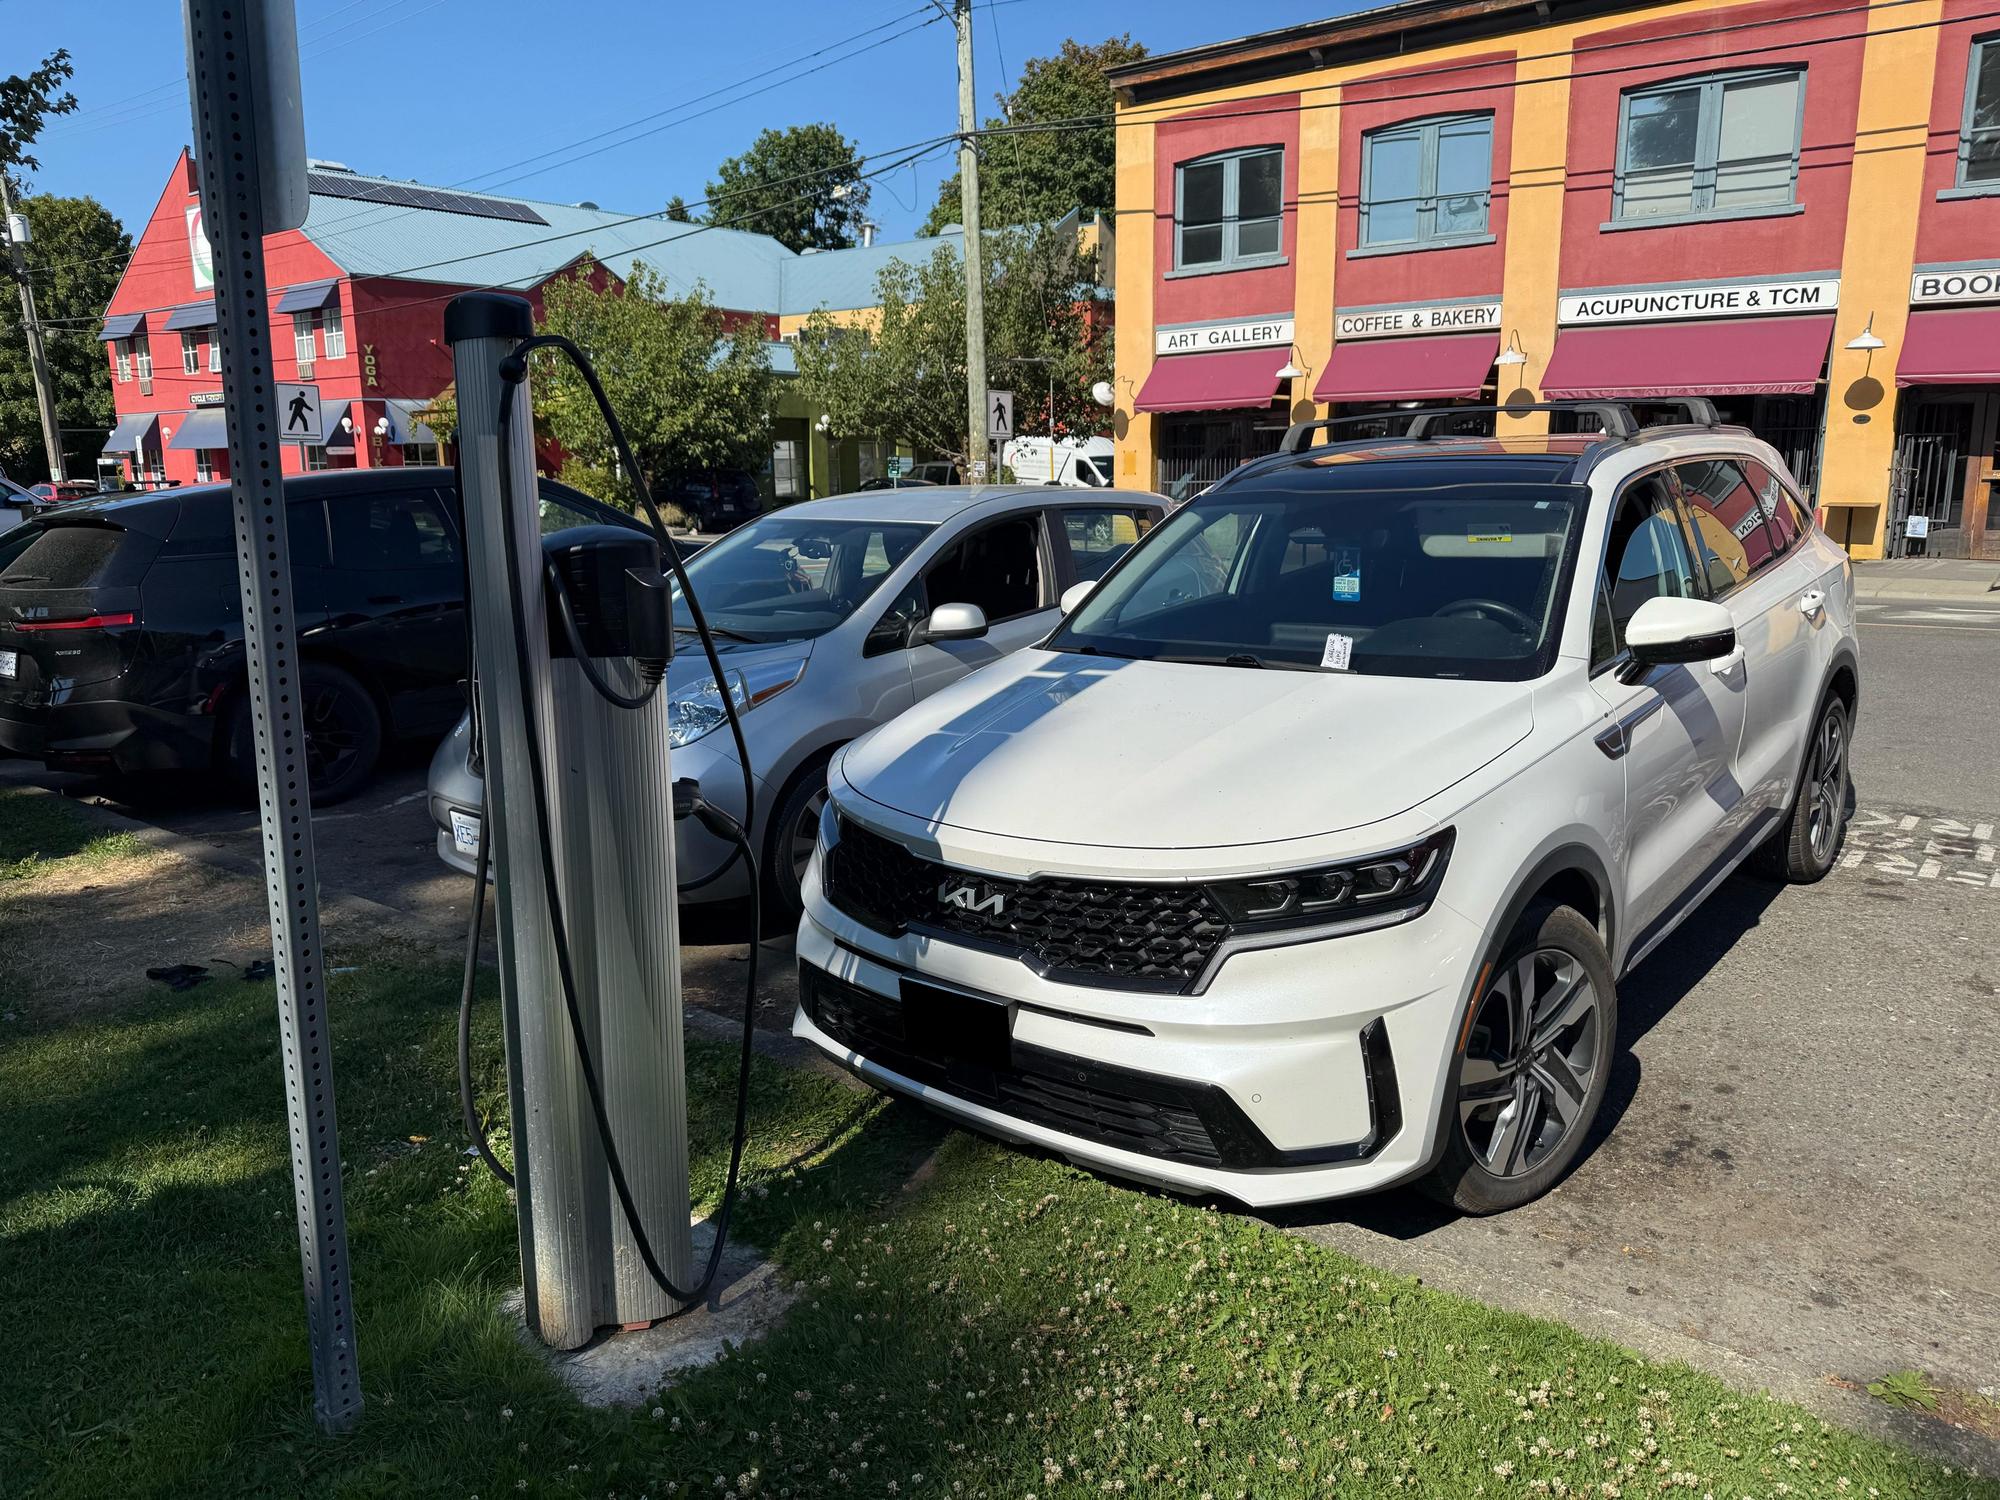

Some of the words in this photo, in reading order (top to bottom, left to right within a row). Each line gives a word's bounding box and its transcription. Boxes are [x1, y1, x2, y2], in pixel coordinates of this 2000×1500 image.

[1576, 291, 1740, 318] ACUPUNCTURE
[1747, 290, 1761, 307] &
[1770, 286, 1821, 305] TCM
[1167, 332, 1198, 349] ART
[1208, 325, 1283, 346] GALLERY
[1341, 314, 1403, 334] COFFEE
[1411, 313, 1423, 329] &
[1430, 308, 1498, 328] BAKERY
[362, 344, 378, 387] YOGA
[372, 436, 384, 469] BIK
